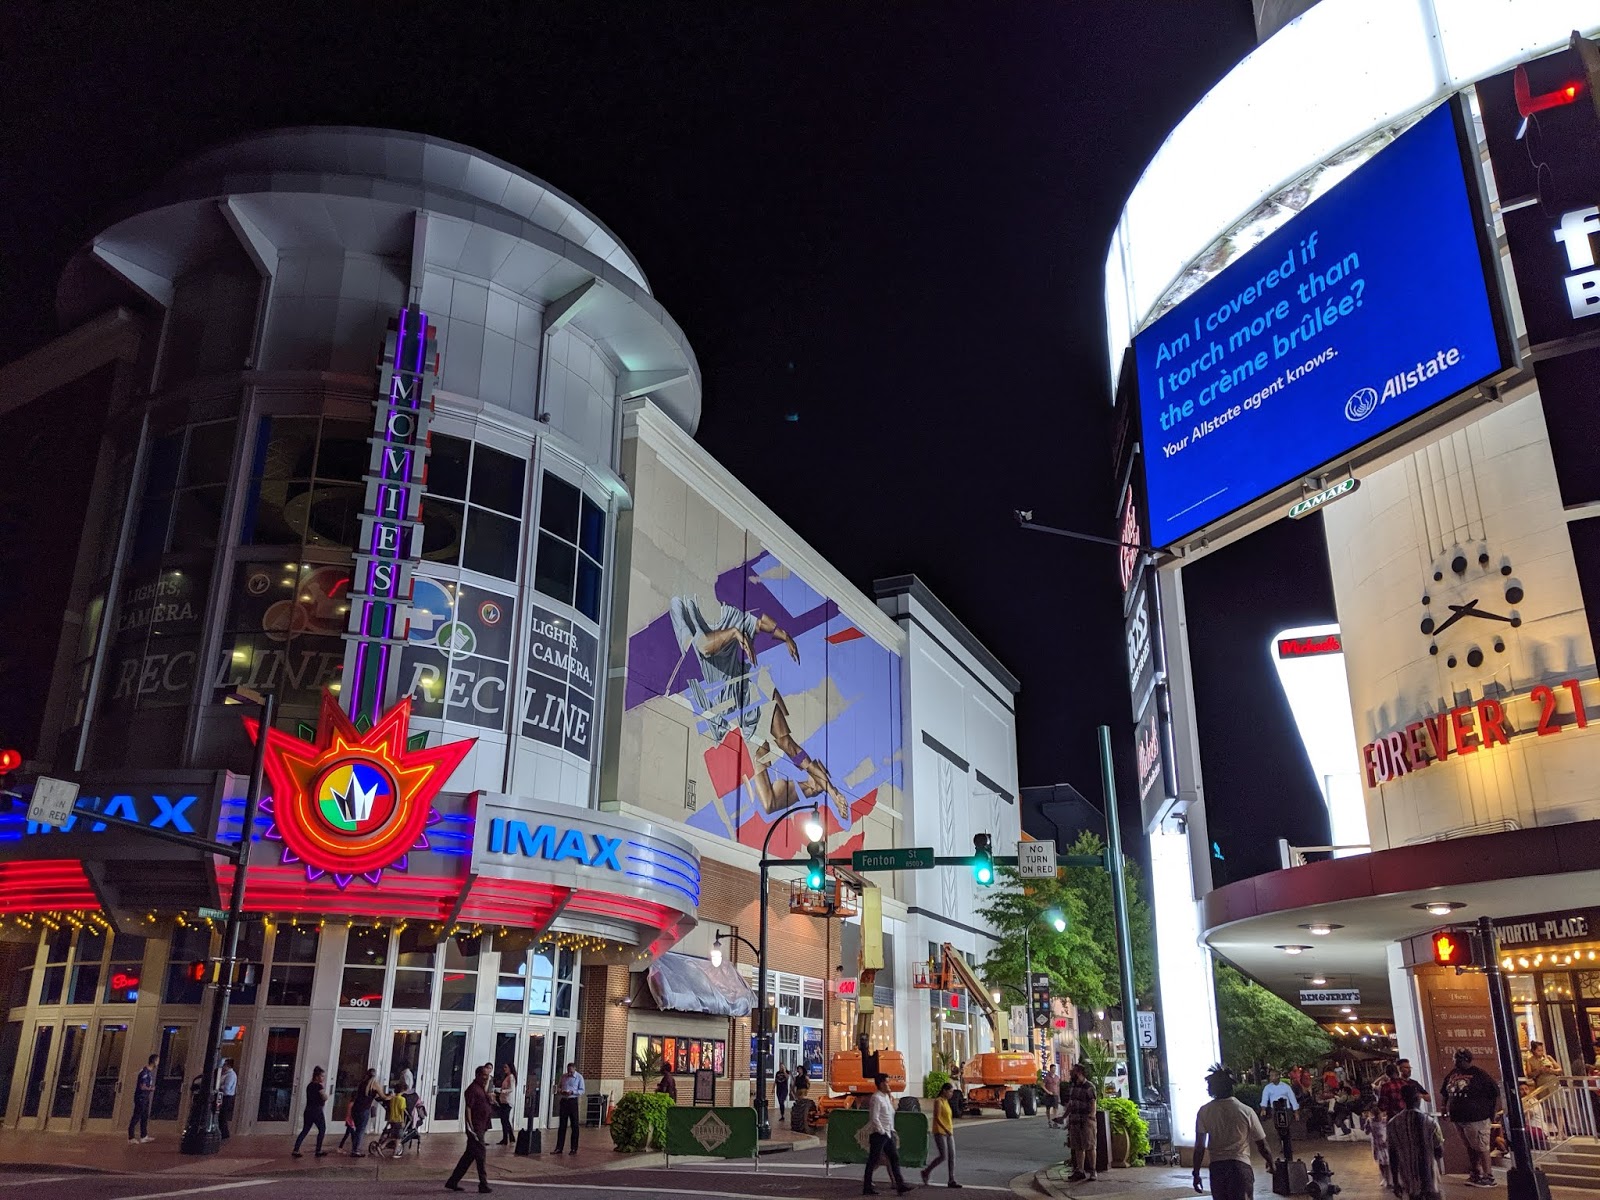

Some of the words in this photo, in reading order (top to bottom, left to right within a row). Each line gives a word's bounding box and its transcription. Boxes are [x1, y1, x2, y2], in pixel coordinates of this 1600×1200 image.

[1155, 332, 1190, 369] Am
[1194, 317, 1201, 341] I
[1206, 249, 1296, 331] covered
[1300, 230, 1318, 265] if
[1158, 376, 1165, 400] I
[1168, 342, 1224, 392] torch
[1229, 300, 1290, 353] more
[1297, 251, 1360, 304] than
[1159, 399, 1194, 431] the
[1199, 350, 1269, 407] crème
[1272, 278, 1365, 360] brûlée?
[1380, 347, 1460, 405] Allstate
[1162, 436, 1189, 459] Your
[1191, 405, 1242, 443] Allstate
[1243, 377, 1285, 410] agent
[1286, 347, 1339, 385] knows.
[373, 376, 418, 590] MOVIES
[1293, 481, 1349, 515] LAMAR
[532, 617, 579, 652] LIGHTS,
[532, 642, 593, 688] CAMERA,
[402, 662, 505, 714] REC
[523, 686, 590, 745] LINE
[1363, 699, 1510, 788] FOREVER
[1530, 678, 1588, 737] 21
[488, 817, 622, 872] IMAX
[862, 854, 895, 866] Fenton
[908, 849, 917, 858] St
[1022, 865, 1034, 874] ON
[1037, 865, 1053, 873] RED
[1026, 855, 1048, 863] TURN
[1029, 845, 1043, 853] NO
[350, 998, 370, 1007] 900
[1144, 1030, 1152, 1043] 5
